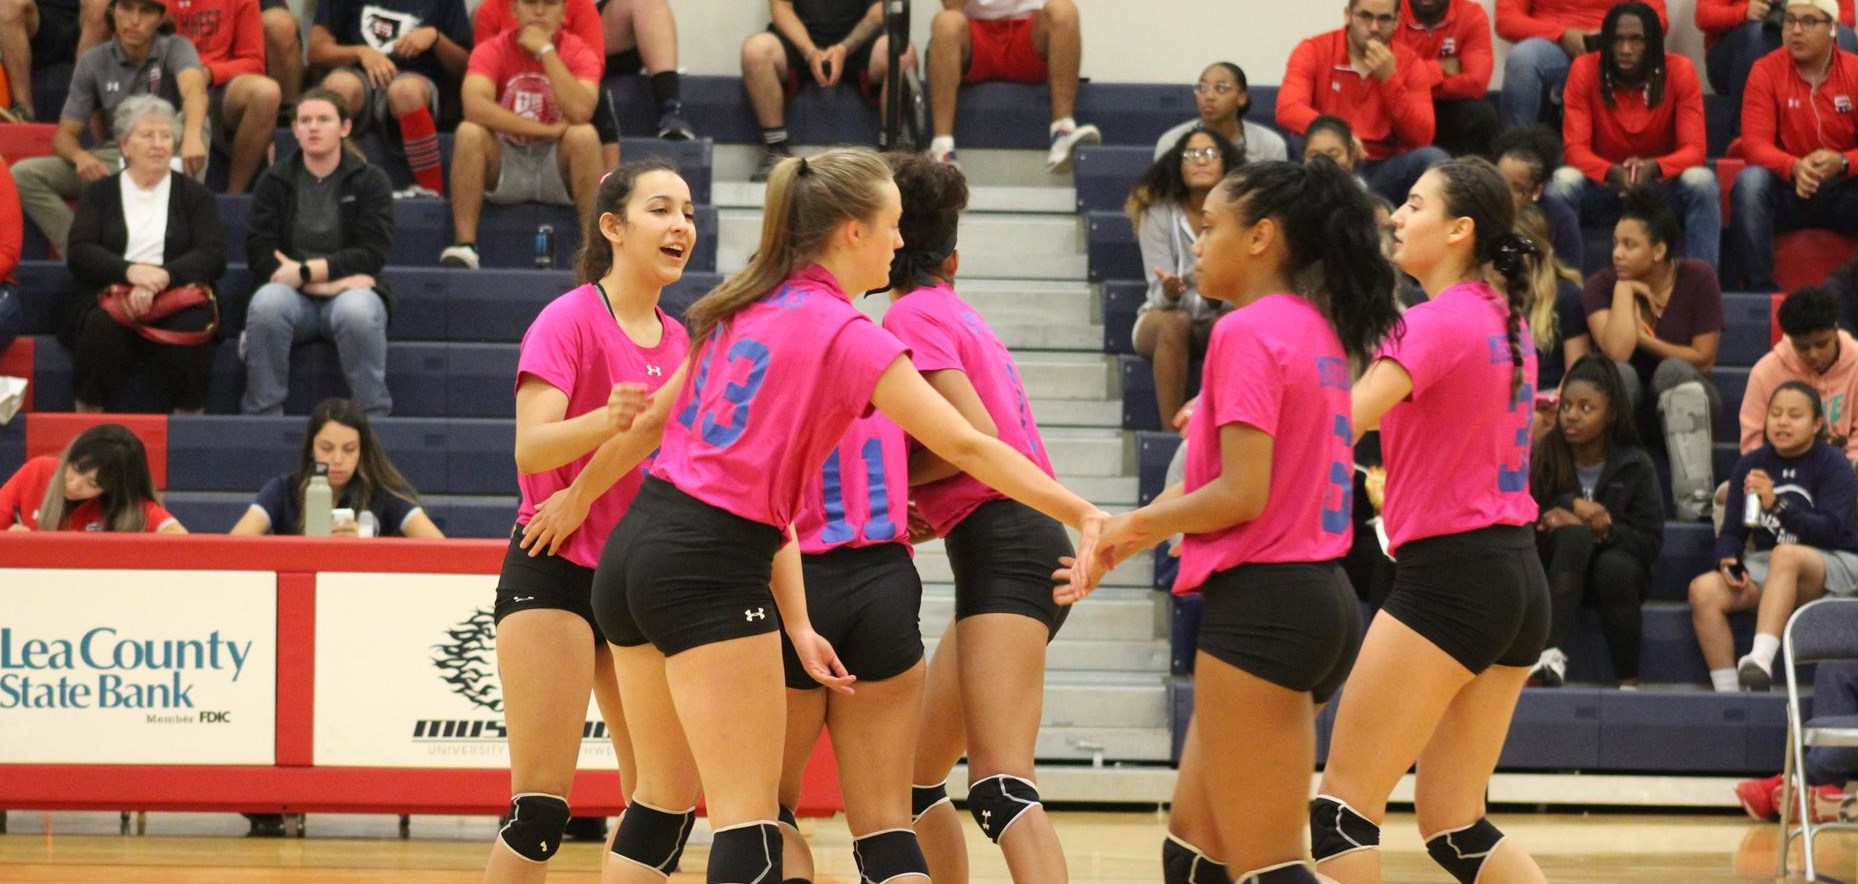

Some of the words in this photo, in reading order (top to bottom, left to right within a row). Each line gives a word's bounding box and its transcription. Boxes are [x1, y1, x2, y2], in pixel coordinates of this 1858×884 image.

[677, 321, 770, 449] 13
[821, 438, 896, 543] 11
[1, 627, 75, 670] Lea
[80, 627, 253, 682] County
[0, 673, 91, 708] State
[98, 671, 194, 708] Bank
[146, 714, 195, 724] Member
[200, 711, 231, 723] FDIC
